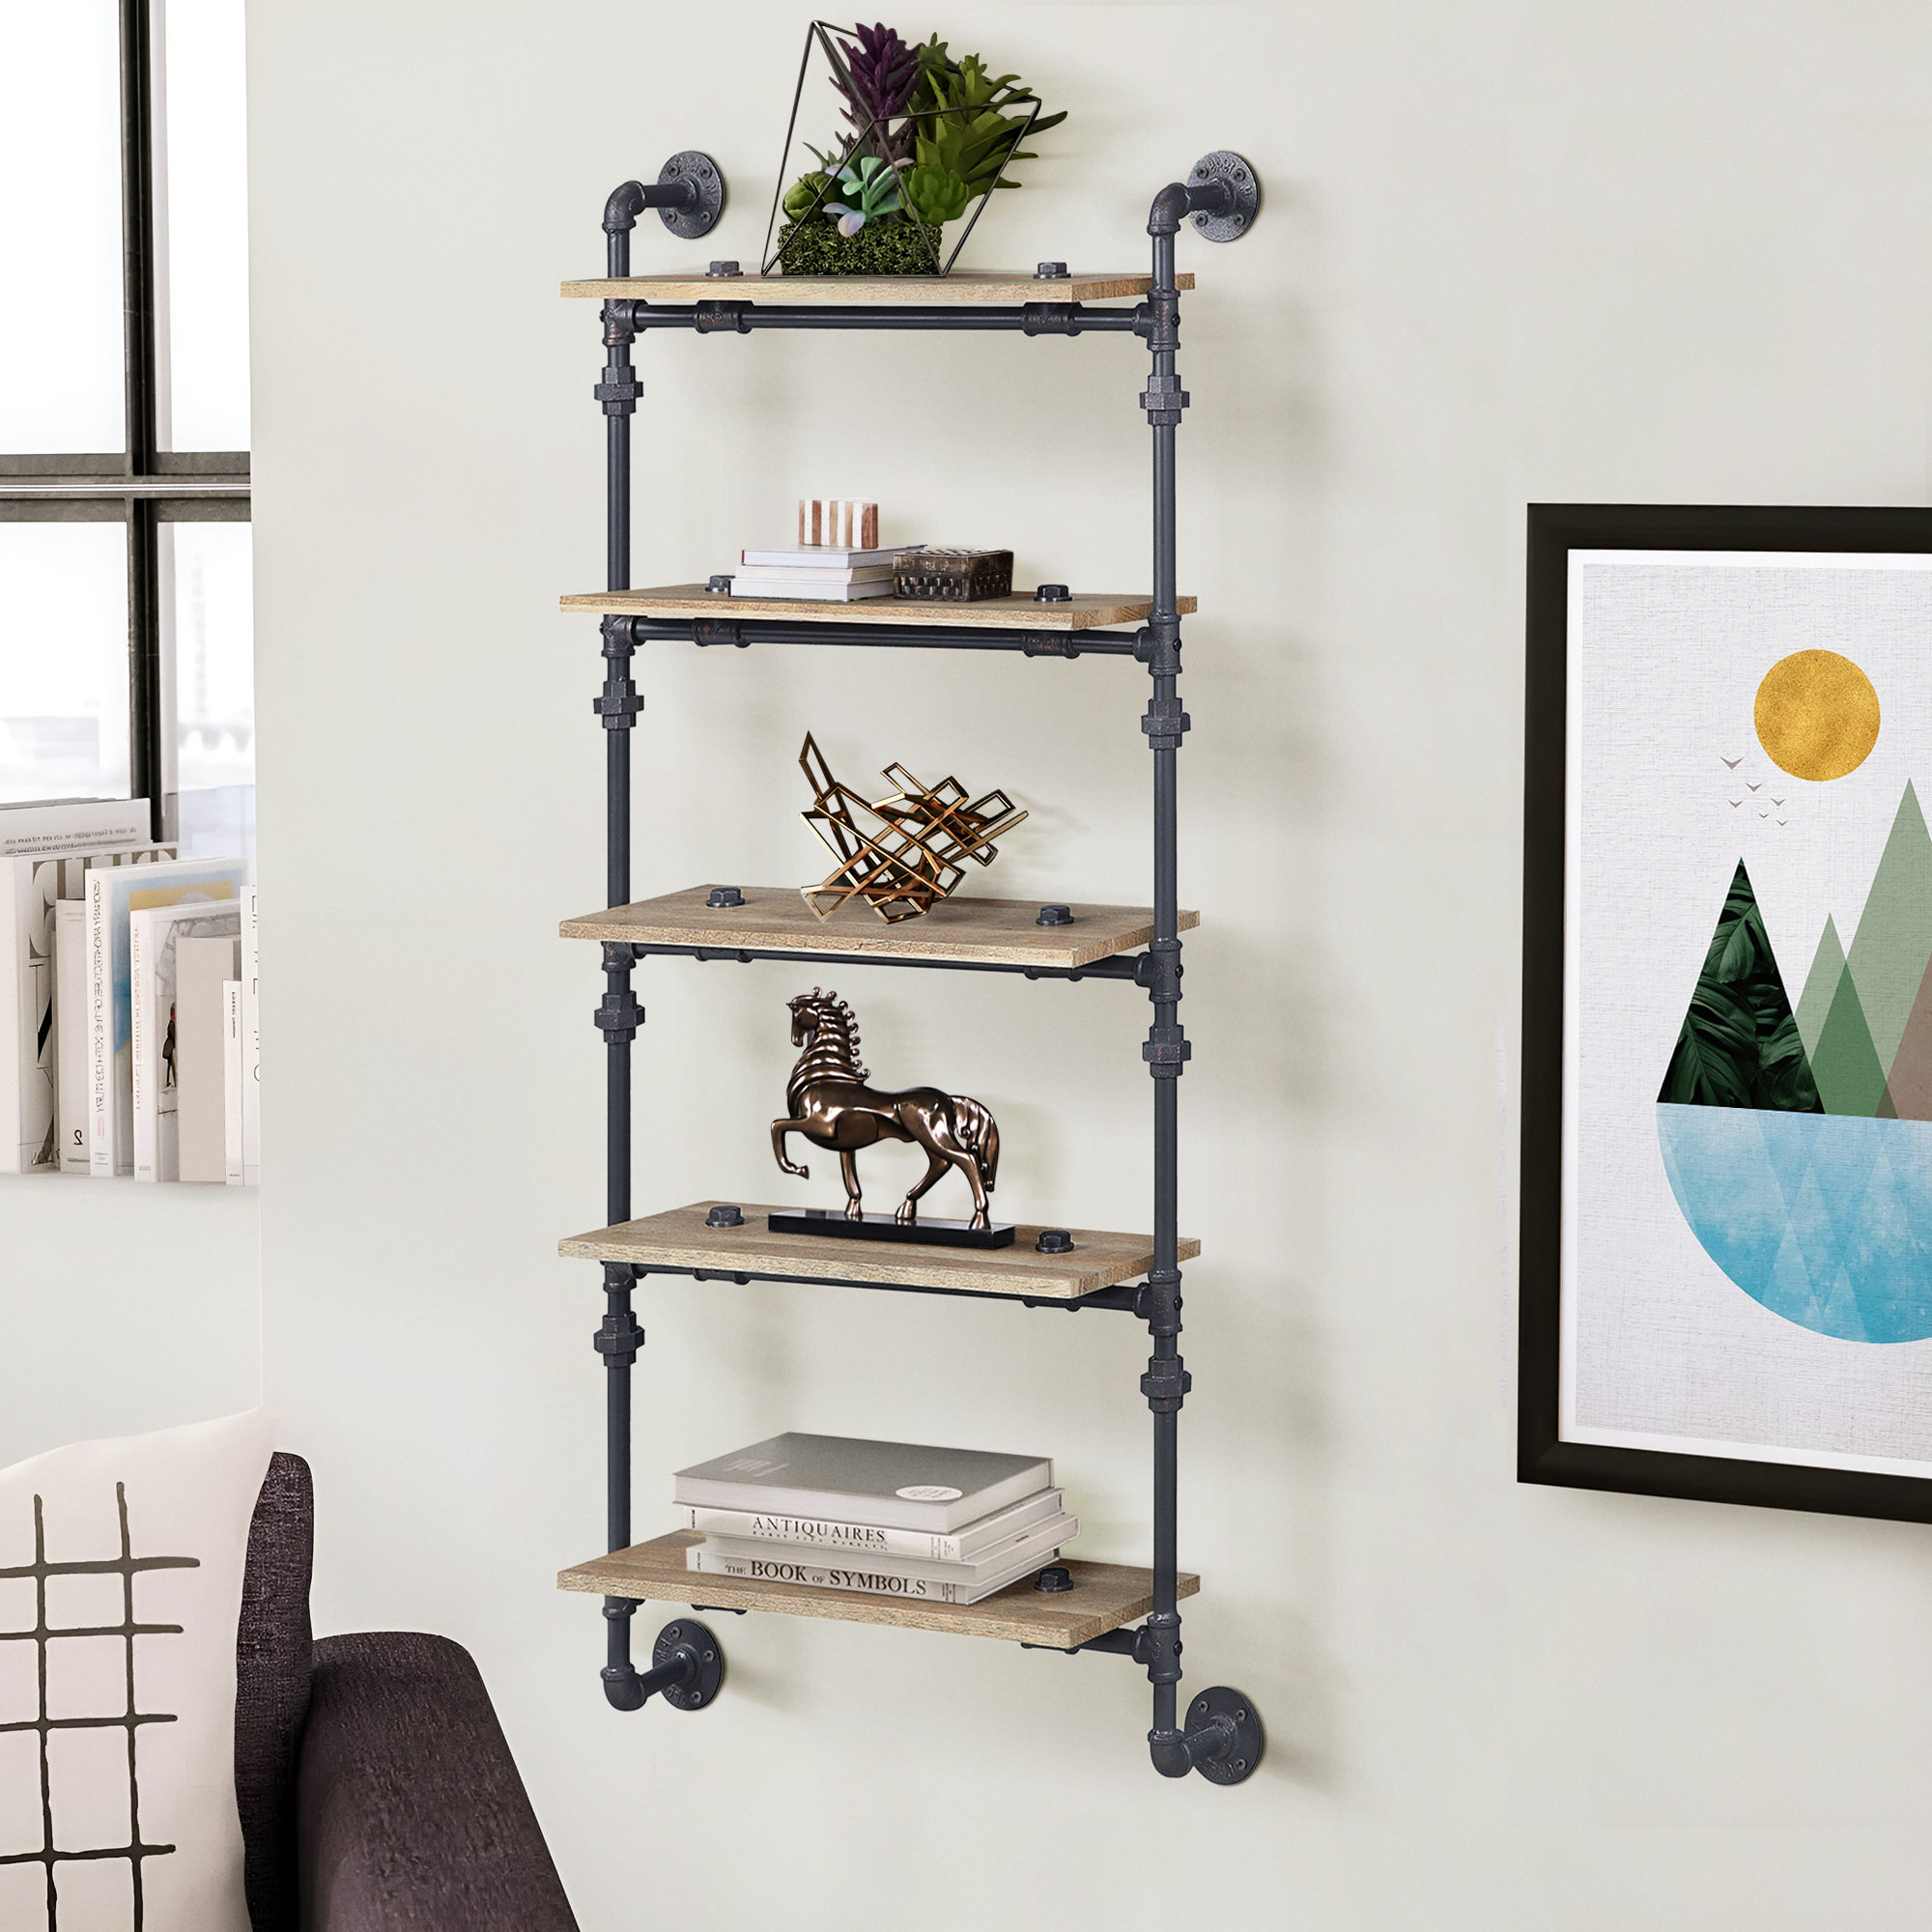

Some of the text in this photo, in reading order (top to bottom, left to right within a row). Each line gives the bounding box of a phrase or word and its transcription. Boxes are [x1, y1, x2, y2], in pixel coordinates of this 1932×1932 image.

[753, 1517, 886, 1543] ANTIQUAIRES
[724, 1564, 747, 1575] THE
[751, 1560, 808, 1582] BOOK
[830, 1570, 926, 1595] SYMBOLS
